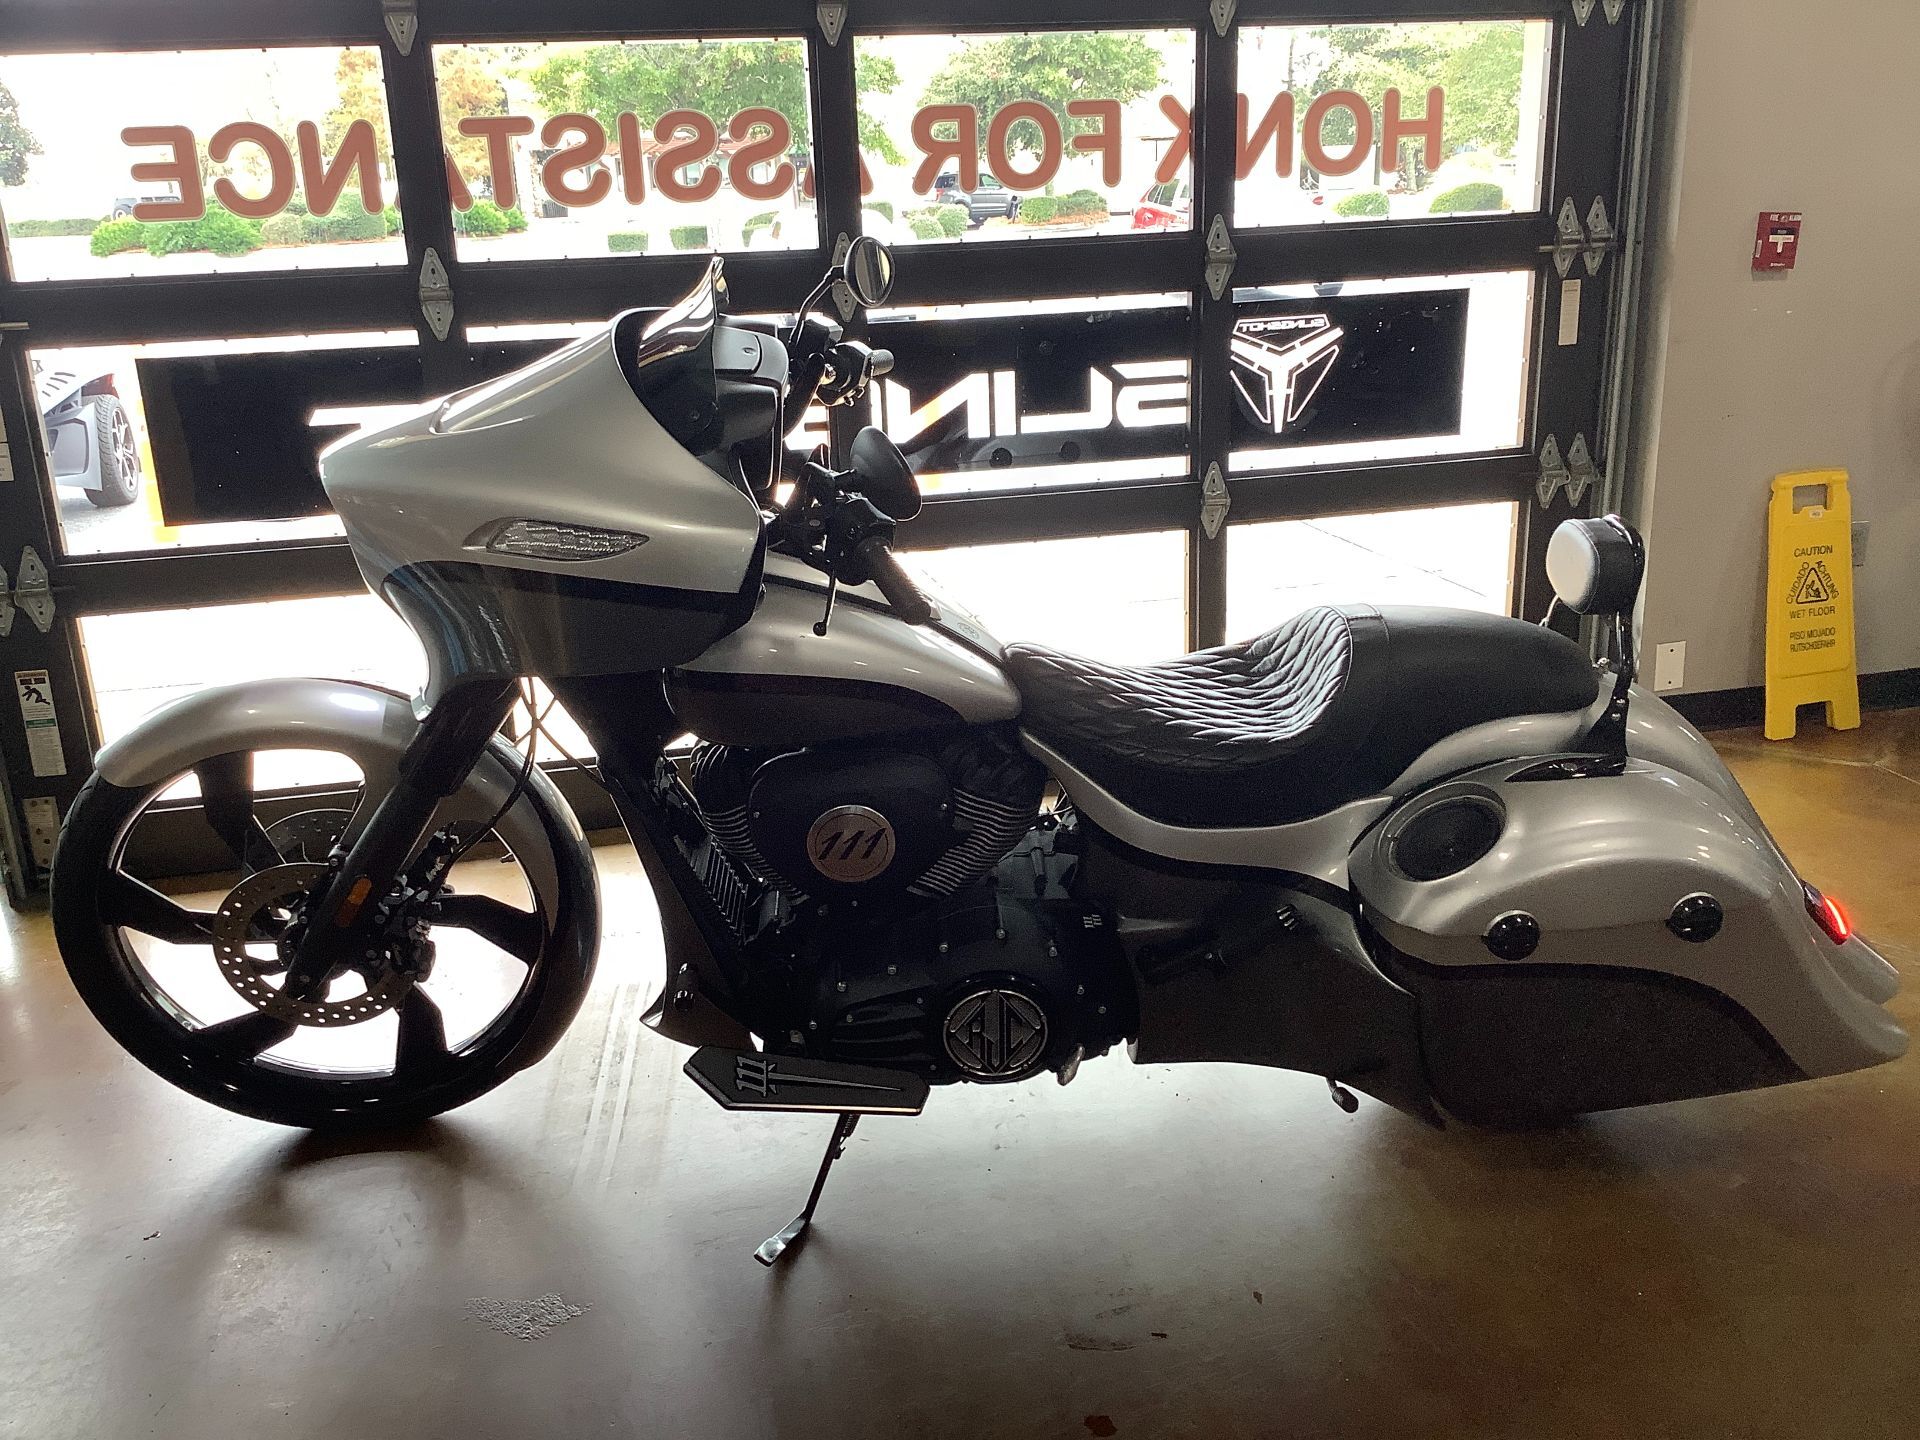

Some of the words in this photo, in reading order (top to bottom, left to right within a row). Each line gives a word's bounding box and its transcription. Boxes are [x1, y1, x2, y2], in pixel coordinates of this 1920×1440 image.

[1794, 545, 1833, 557] CAUTION
[1786, 561, 1810, 604] CUIDADO
[1815, 560, 1840, 600] ACHTUNG
[1789, 609, 1806, 619] WET
[1808, 605, 1836, 616] FLOOR
[1789, 630, 1806, 640] PISO
[818, 827, 887, 861] 111
